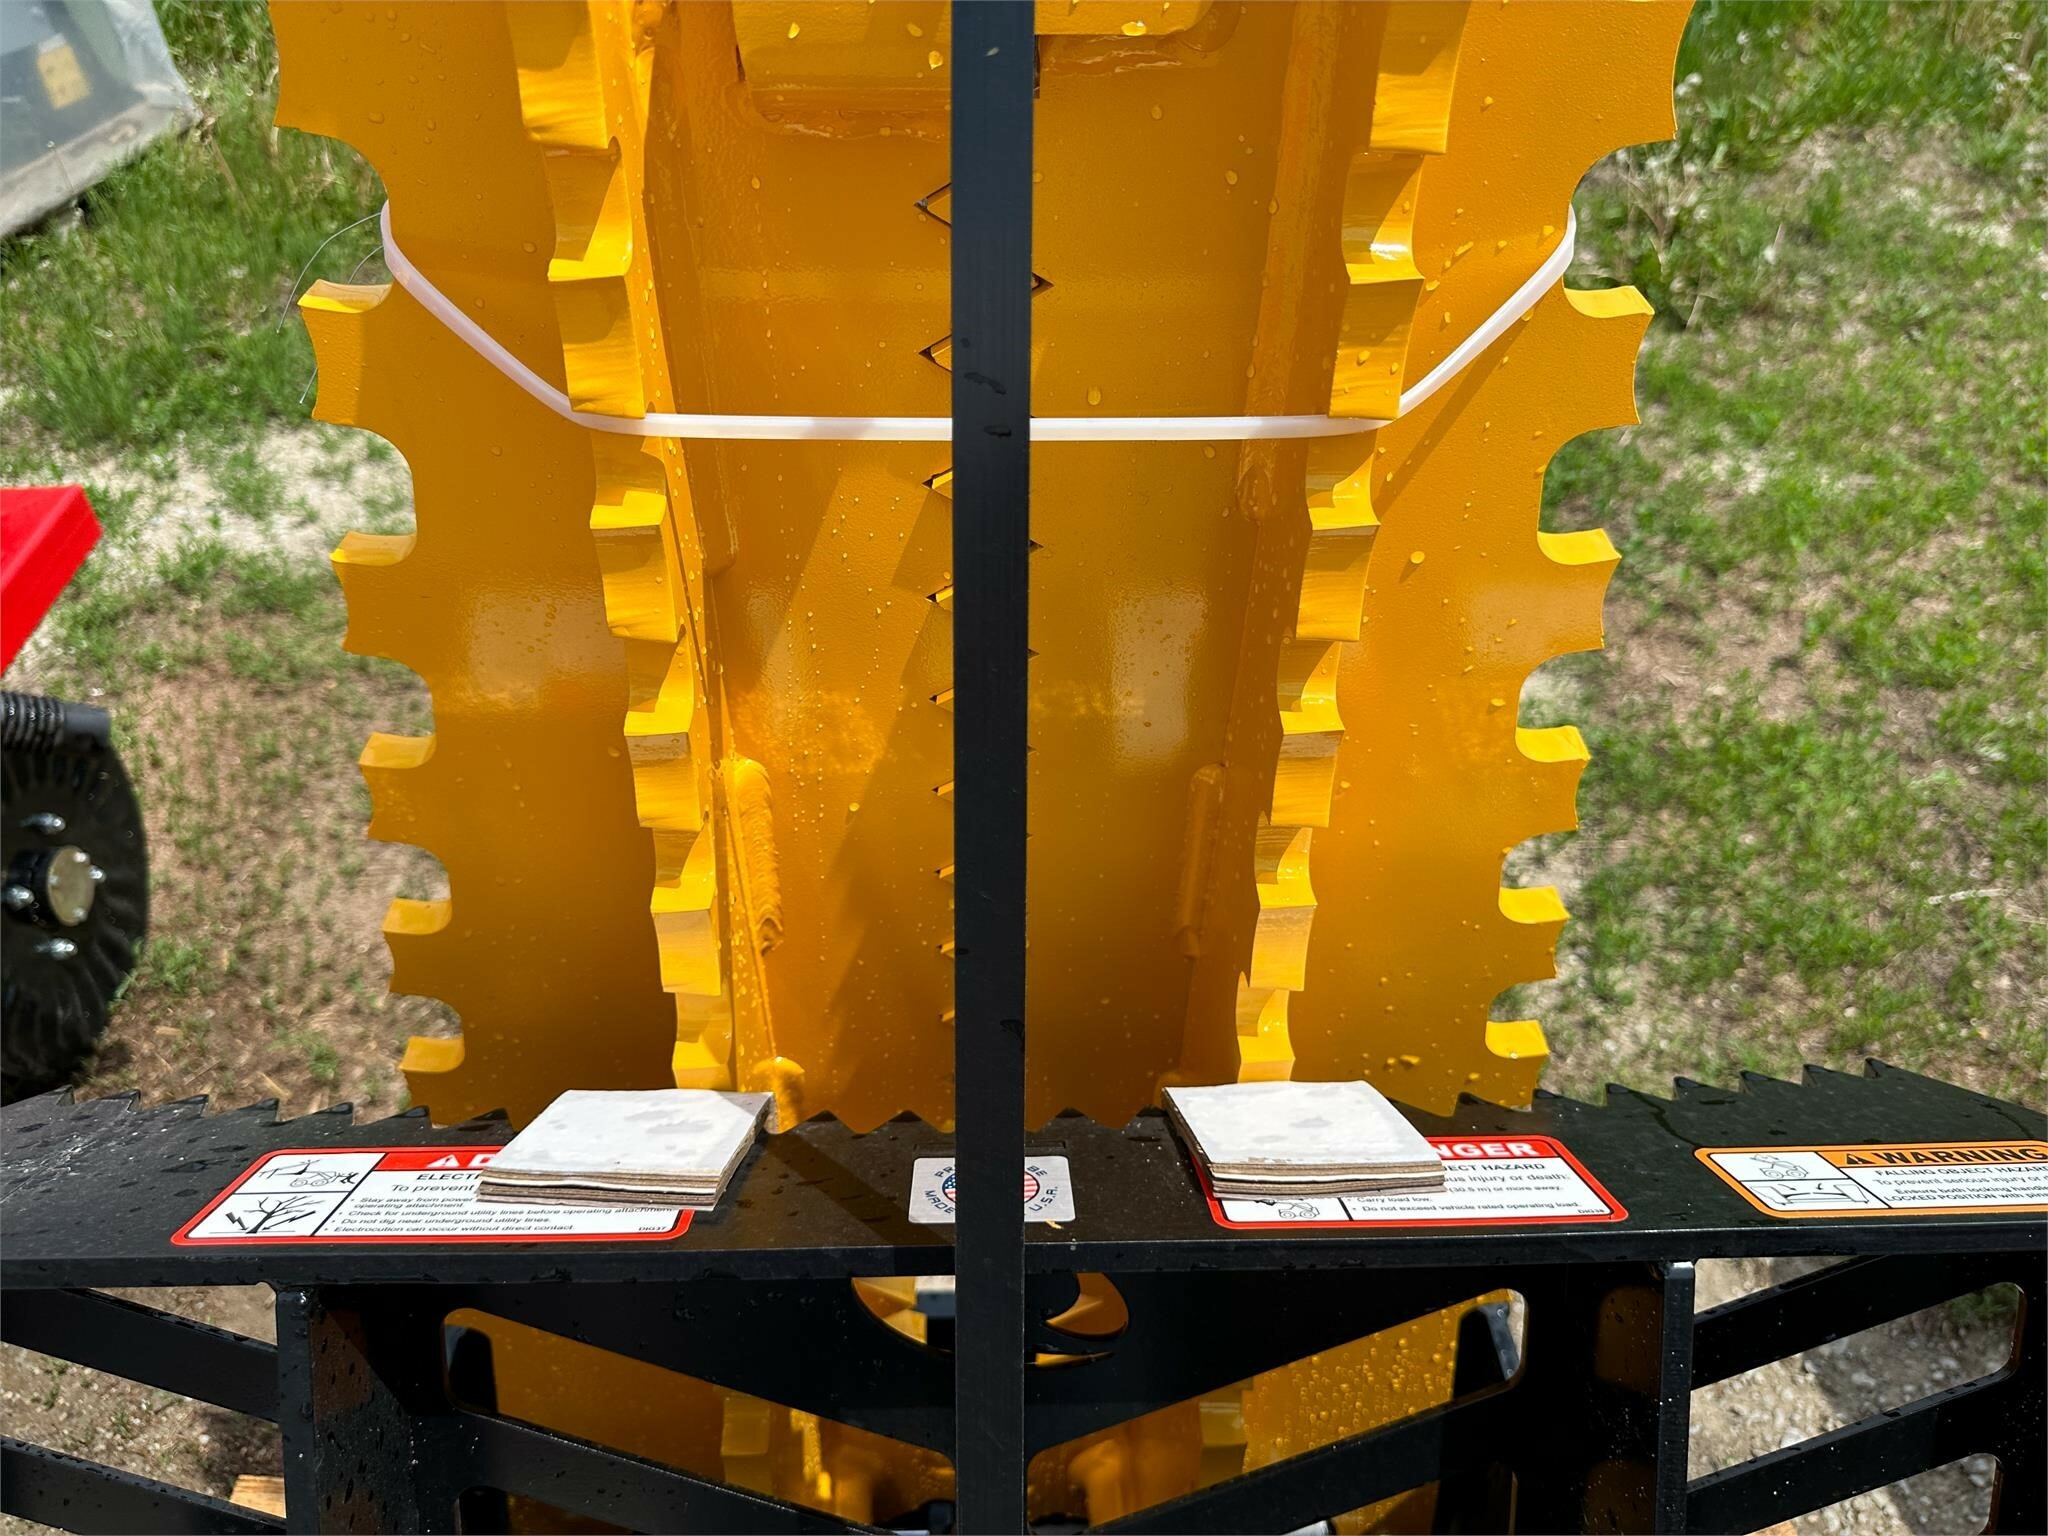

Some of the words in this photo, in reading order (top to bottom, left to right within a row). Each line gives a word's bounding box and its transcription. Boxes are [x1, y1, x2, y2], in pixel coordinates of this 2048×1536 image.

[1433, 1142, 1540, 1158] NGER
[1871, 1148, 2048, 1164] WARNING
[1027, 1165, 1048, 1177] BE
[1481, 1163, 1545, 1171] HAZARD
[1875, 1168, 1936, 1176] FALLING
[1937, 1167, 1993, 1175] OBJECT
[1468, 1174, 1505, 1183] injury
[1894, 1178, 1943, 1186] prevent
[1990, 1176, 2026, 1184] injury
[391, 1184, 408, 1192] To
[412, 1184, 475, 1193] prevent
[924, 1190, 956, 1214] MADE
[1884, 1194, 1937, 1202] LOCKED
[1506, 1202, 1555, 1210] operating
